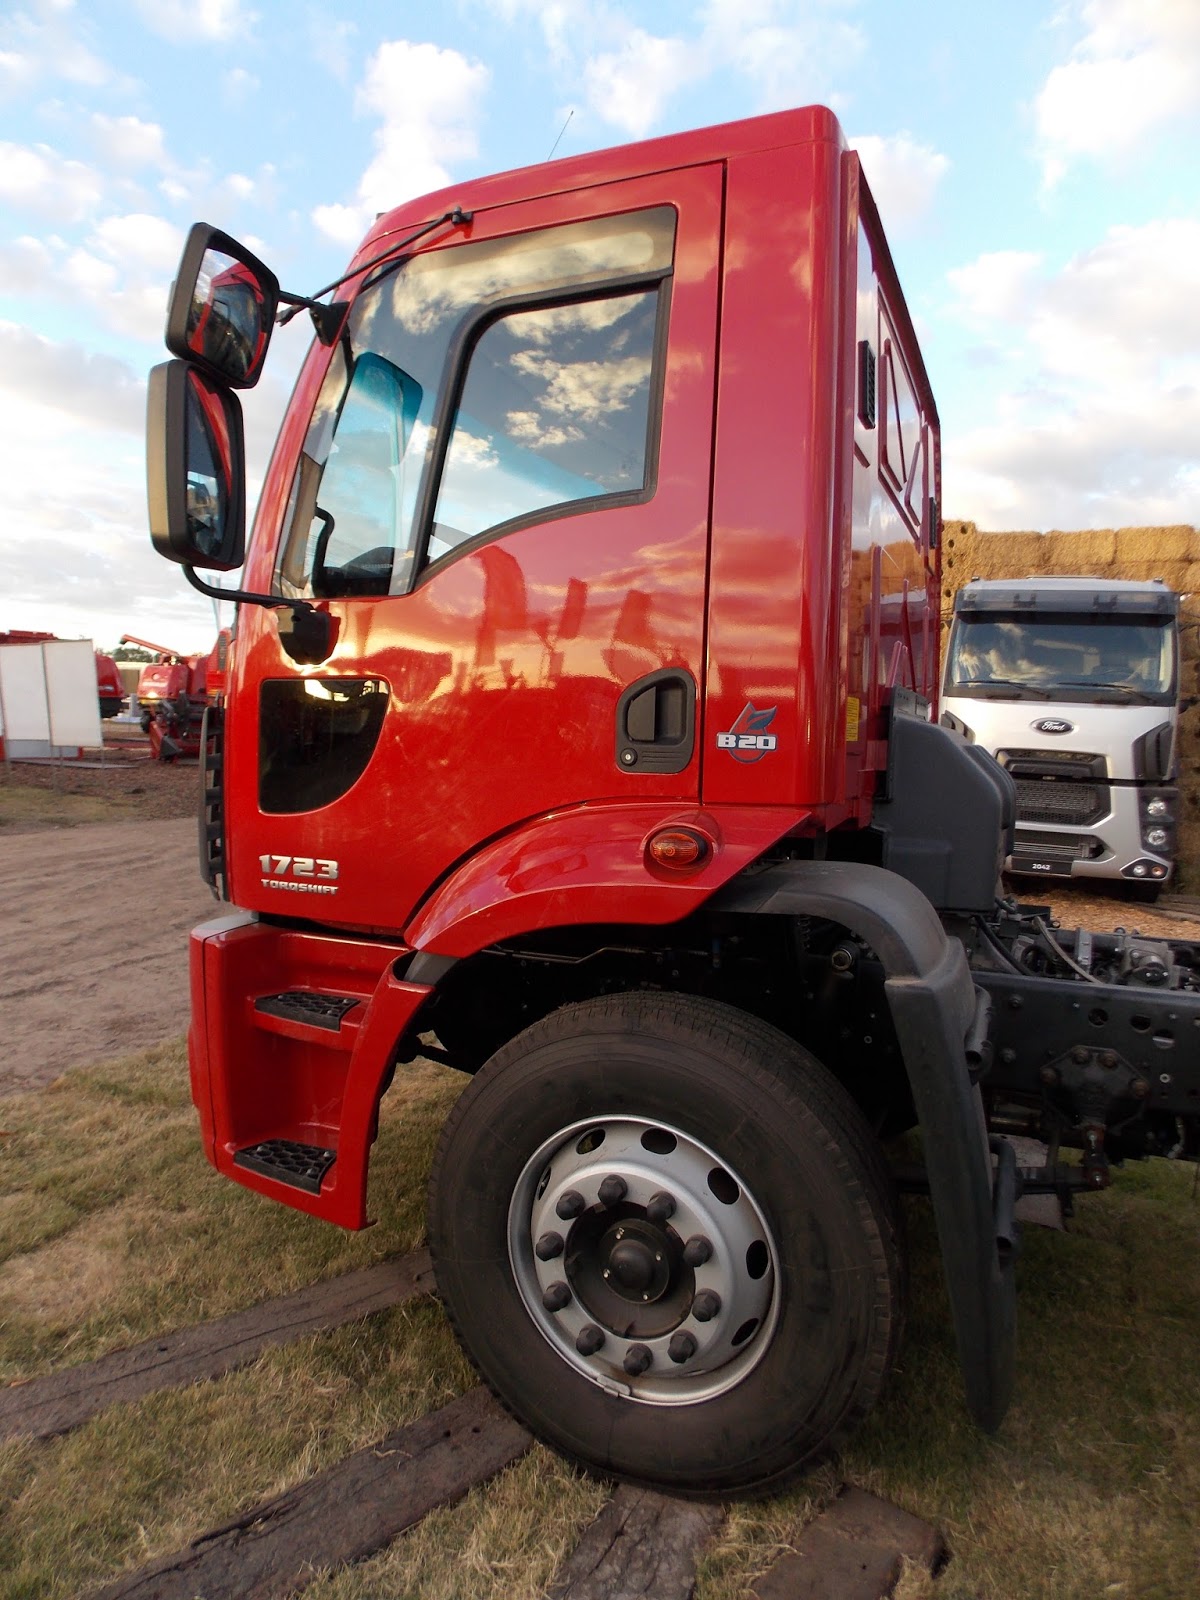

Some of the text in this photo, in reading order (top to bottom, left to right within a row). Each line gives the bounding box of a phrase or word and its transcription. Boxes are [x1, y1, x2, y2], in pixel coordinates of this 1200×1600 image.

[1041, 720, 1066, 731] Ford
[717, 733, 777, 750] B20
[258, 854, 339, 879] 1723
[260, 878, 339, 895] TORQSHIFT
